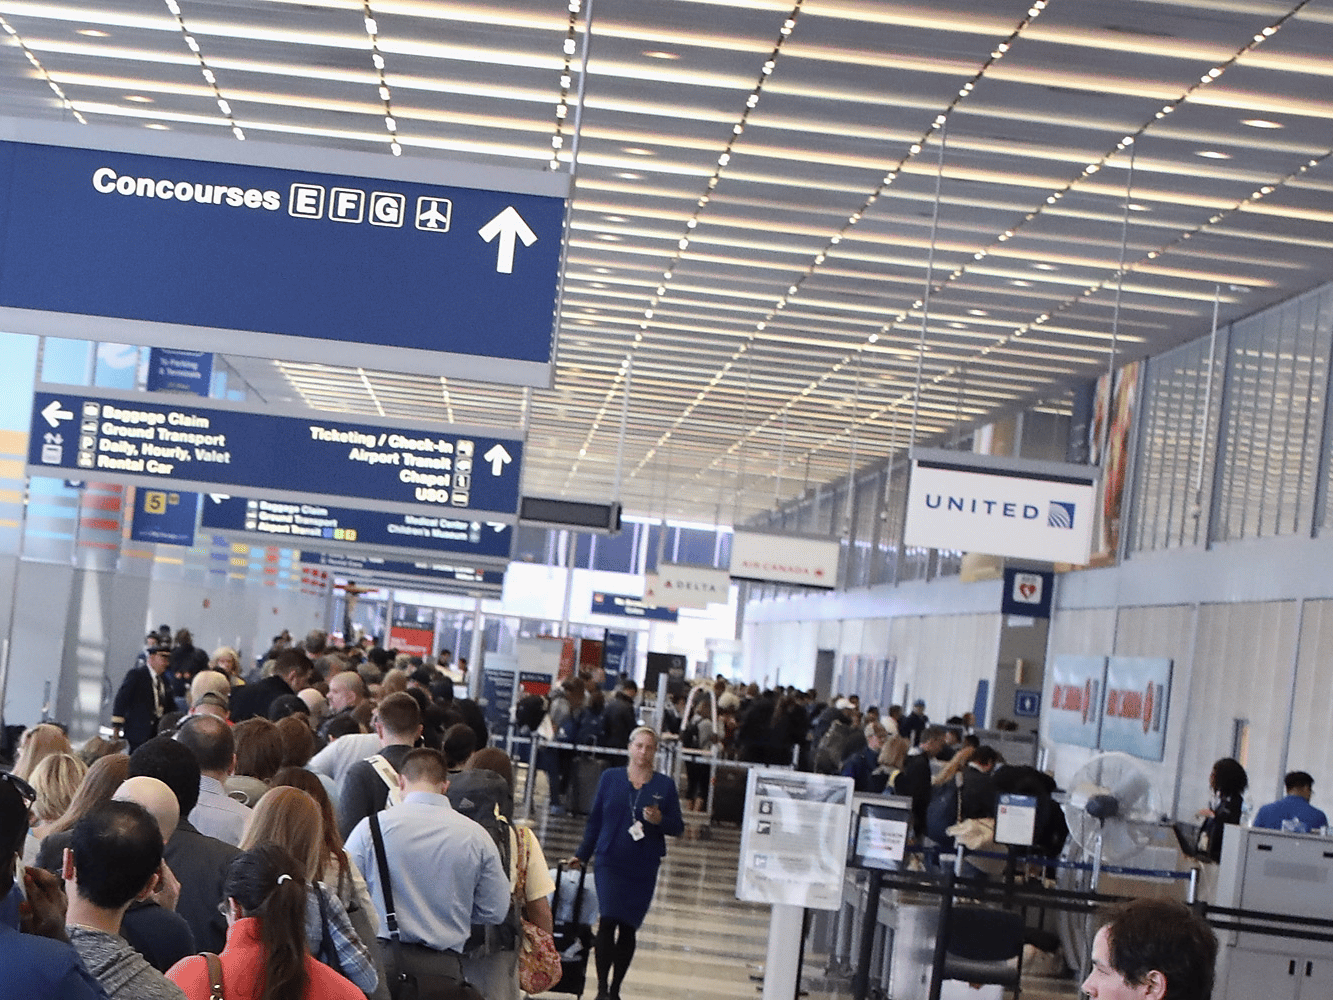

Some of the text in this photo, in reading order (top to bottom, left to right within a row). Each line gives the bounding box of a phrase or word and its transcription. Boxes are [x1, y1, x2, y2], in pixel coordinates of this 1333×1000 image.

[93, 168, 280, 210] Concourses
[102, 405, 209, 428] Baggage Claim
[101, 422, 226, 447] Ground Transport
[309, 426, 454, 454] Ticketing / Check-in
[99, 438, 139, 456] Daily,
[141, 443, 191, 461] Hourly,
[194, 448, 231, 463] Valet
[349, 448, 452, 470] Airport Transit
[97, 454, 174, 474] Rental Car
[399, 469, 450, 487] Chapel
[415, 487, 449, 503] USO
[925, 494, 1039, 520] UNITED
[742, 560, 809, 575] AIR CANADA
[676, 580, 716, 593] DELTA
